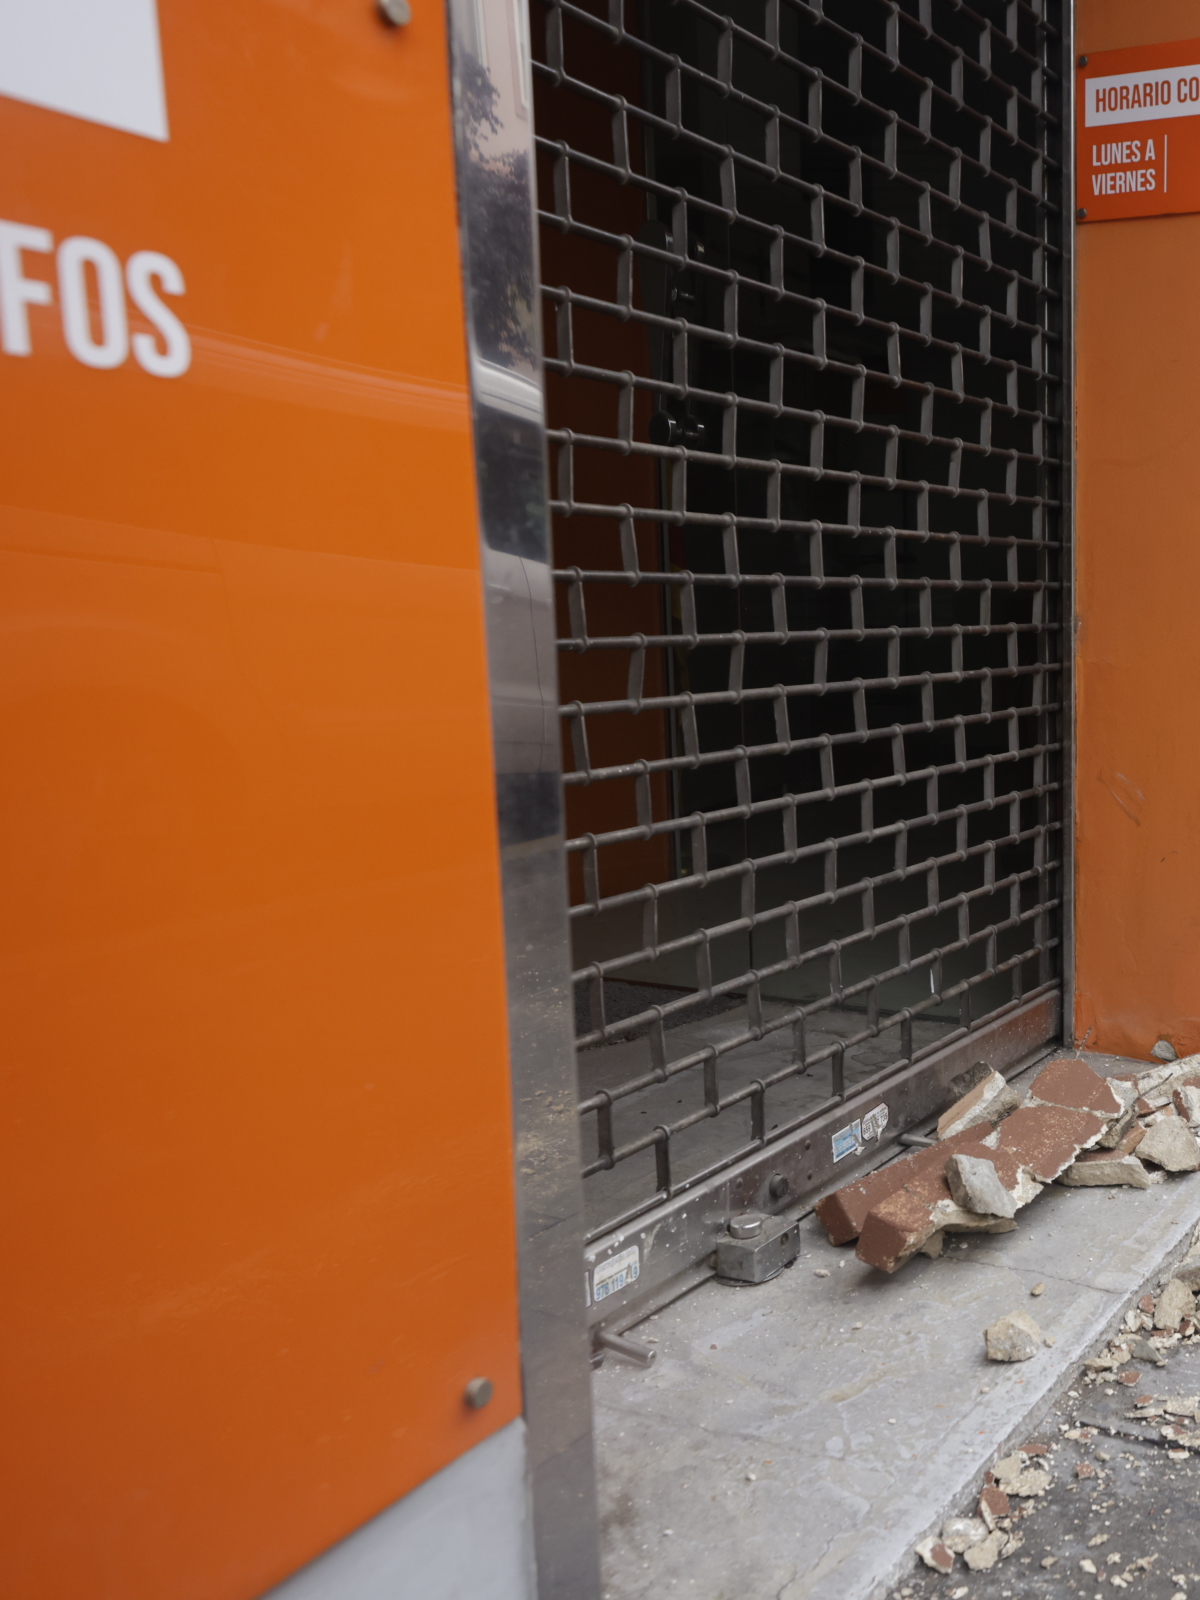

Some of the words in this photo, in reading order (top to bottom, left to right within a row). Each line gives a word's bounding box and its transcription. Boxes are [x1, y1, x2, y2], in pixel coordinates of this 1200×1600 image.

[1095, 80, 1171, 113] HORARIO
[1092, 140, 1141, 166] LUNES
[1145, 139, 1156, 161] A
[1091, 169, 1156, 196] VIERNES
